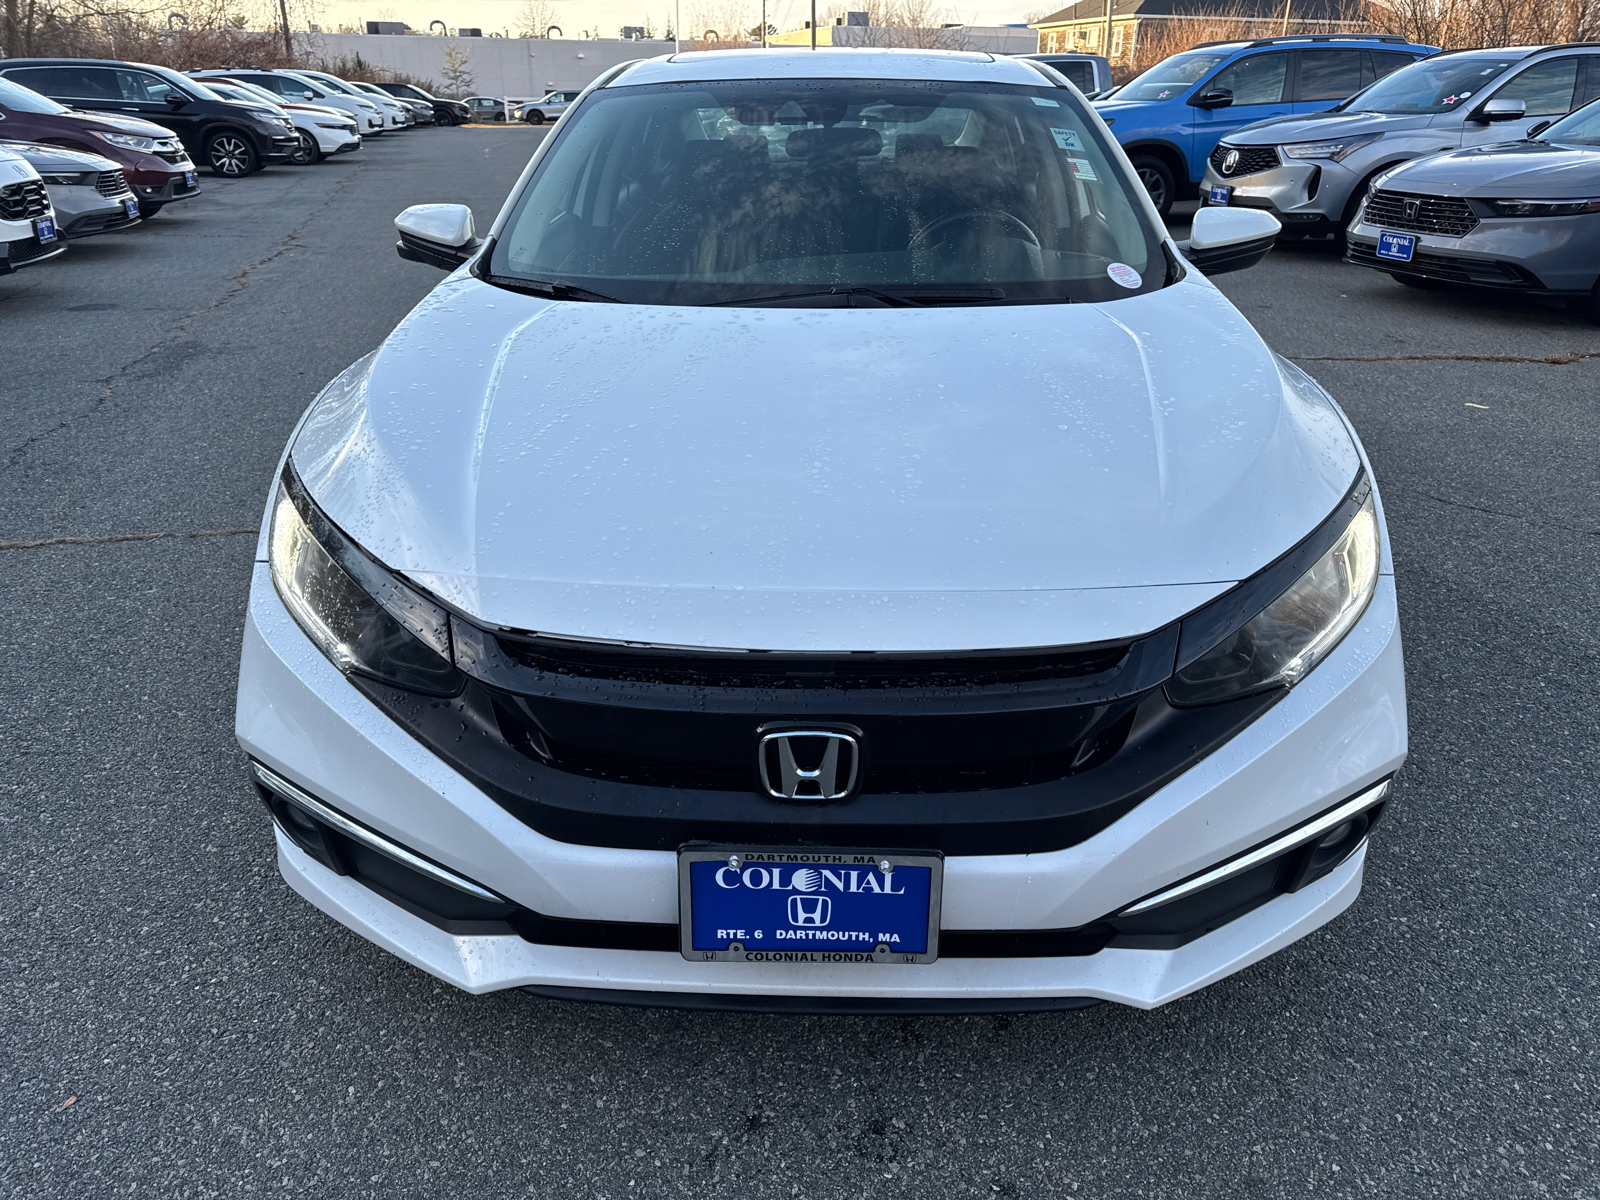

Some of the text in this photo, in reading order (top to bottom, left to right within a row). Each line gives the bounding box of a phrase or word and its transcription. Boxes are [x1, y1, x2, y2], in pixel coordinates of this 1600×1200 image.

[853, 856, 876, 864] MA
[715, 866, 905, 895] COLONIAL
[717, 929, 901, 943] RTE. 6 DARTMOUTH, MA
[745, 952, 874, 962] COLONIAL HONDA
